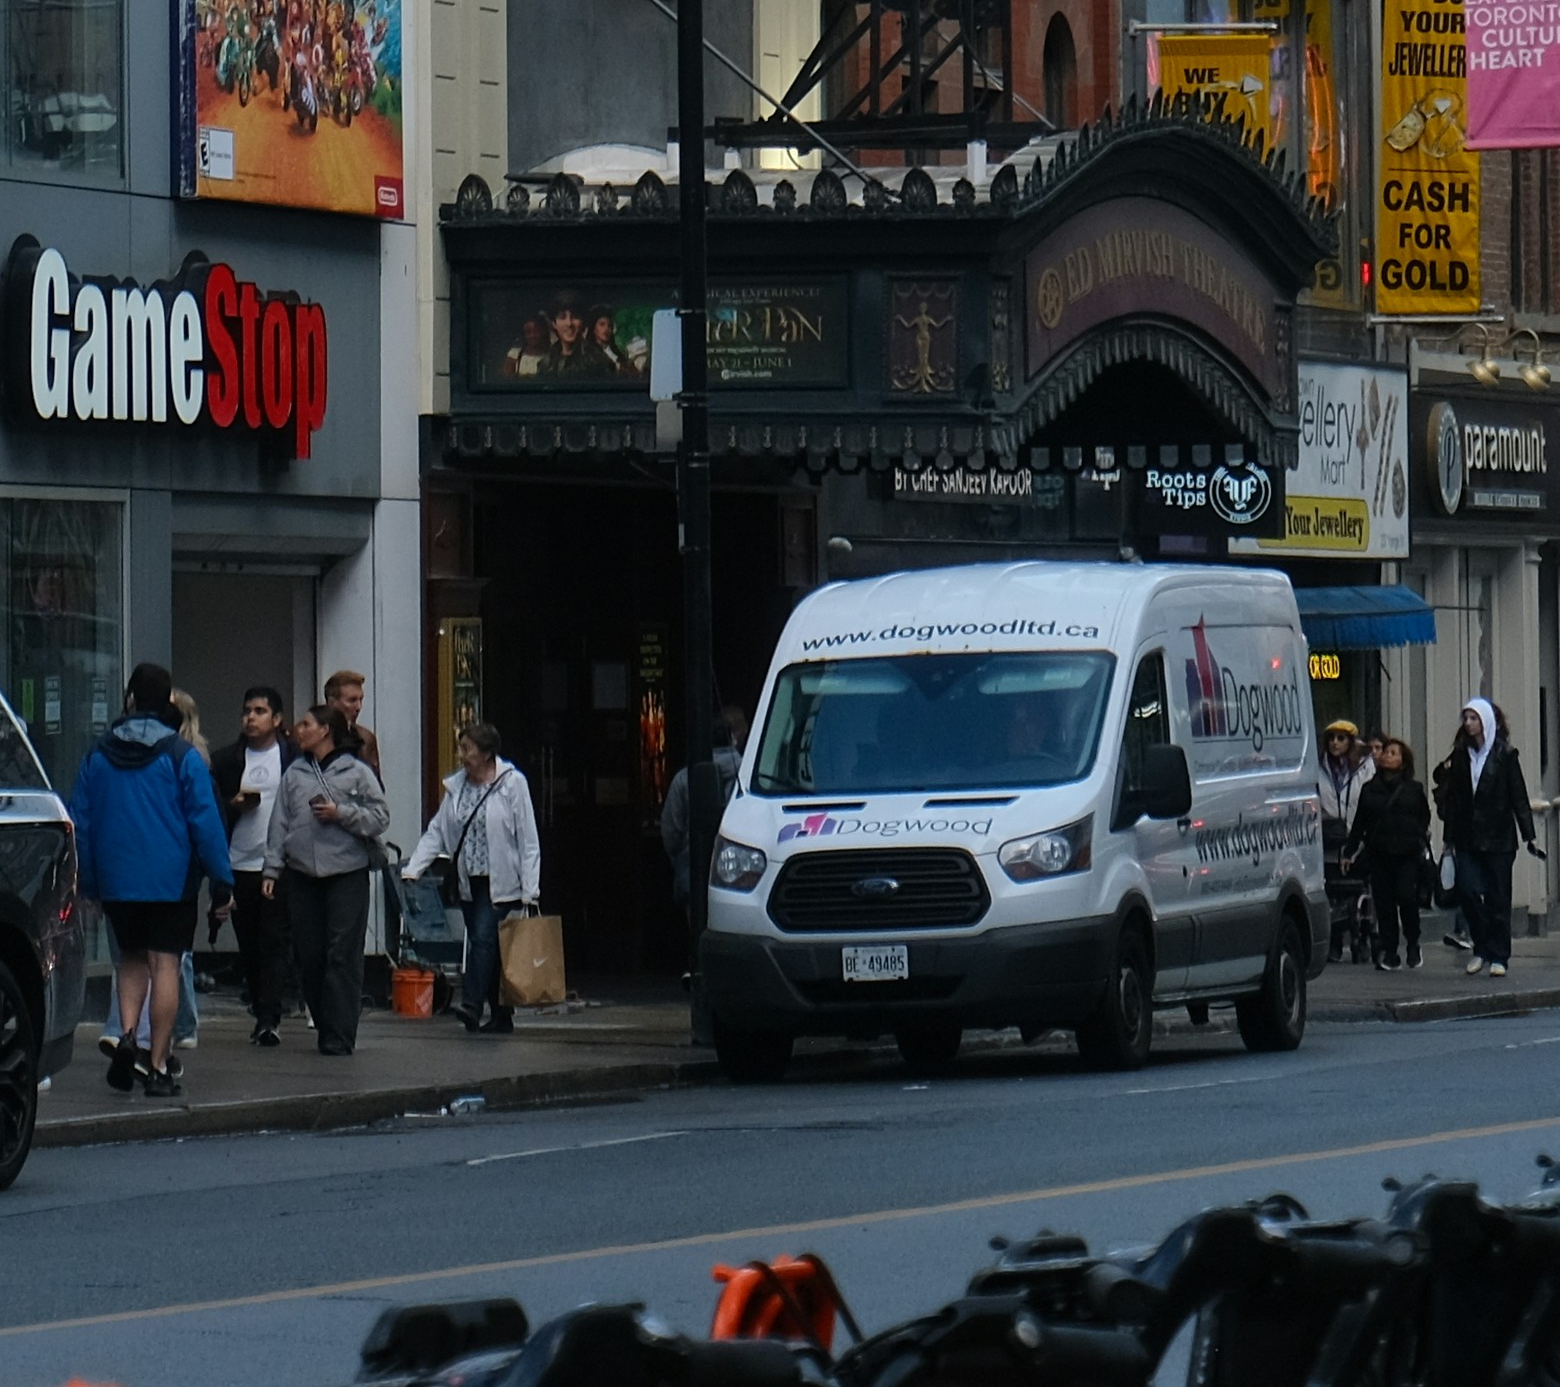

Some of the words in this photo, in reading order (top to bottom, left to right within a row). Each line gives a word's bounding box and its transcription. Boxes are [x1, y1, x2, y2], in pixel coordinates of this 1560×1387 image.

[1400, 9, 1466, 34] YOUR
[1389, 42, 1467, 78] JEWELLER
[1470, 47, 1546, 72] HEART
[1183, 67, 1220, 87] WE
[1181, 91, 1229, 124] BUY
[1383, 180, 1470, 214] CASH
[1399, 223, 1451, 250] FOR
[1381, 258, 1470, 291] GOLD
[706, 287, 737, 299] ICAL
[1064, 246, 1094, 304] ED
[1096, 230, 1175, 284] MIRVISH
[1180, 242, 1266, 356] THEATRE
[29, 246, 327, 460] GameStop
[752, 356, 785, 369] JUNE
[1299, 385, 1356, 464] ellery
[1320, 453, 1346, 486] Mart
[1464, 422, 1548, 487] paramount
[1146, 470, 1207, 490] Roots
[1162, 488, 1206, 509] Tips
[1285, 505, 1311, 536] Your
[1313, 506, 1364, 545] Jewellery
[801, 620, 1099, 653] www.dogwoodltd.ca
[1220, 665, 1302, 753] Dogwood
[837, 817, 994, 837] Dogwood
[845, 956, 860, 973] BE
[868, 955, 905, 973] 49485
